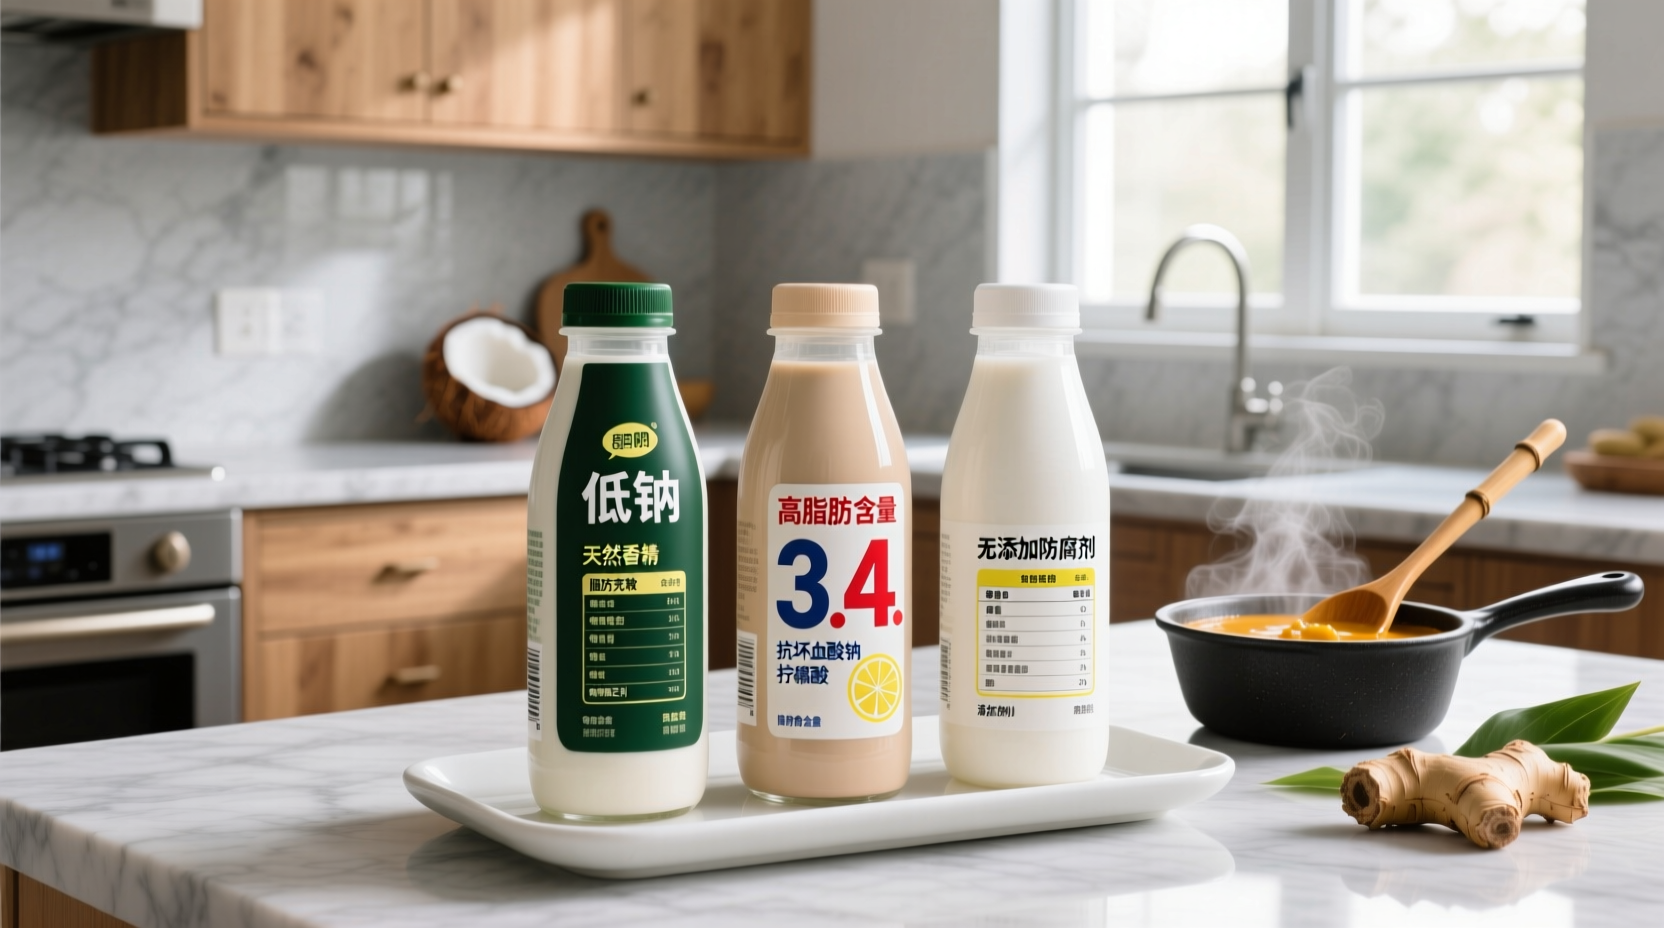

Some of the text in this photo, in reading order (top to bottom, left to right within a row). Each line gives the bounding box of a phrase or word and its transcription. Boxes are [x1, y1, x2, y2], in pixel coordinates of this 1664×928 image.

[581, 470, 680, 524] 低钠
[778, 496, 897, 525] 高脂肪含量
[977, 535, 1095, 560] 无添加防腐剂
